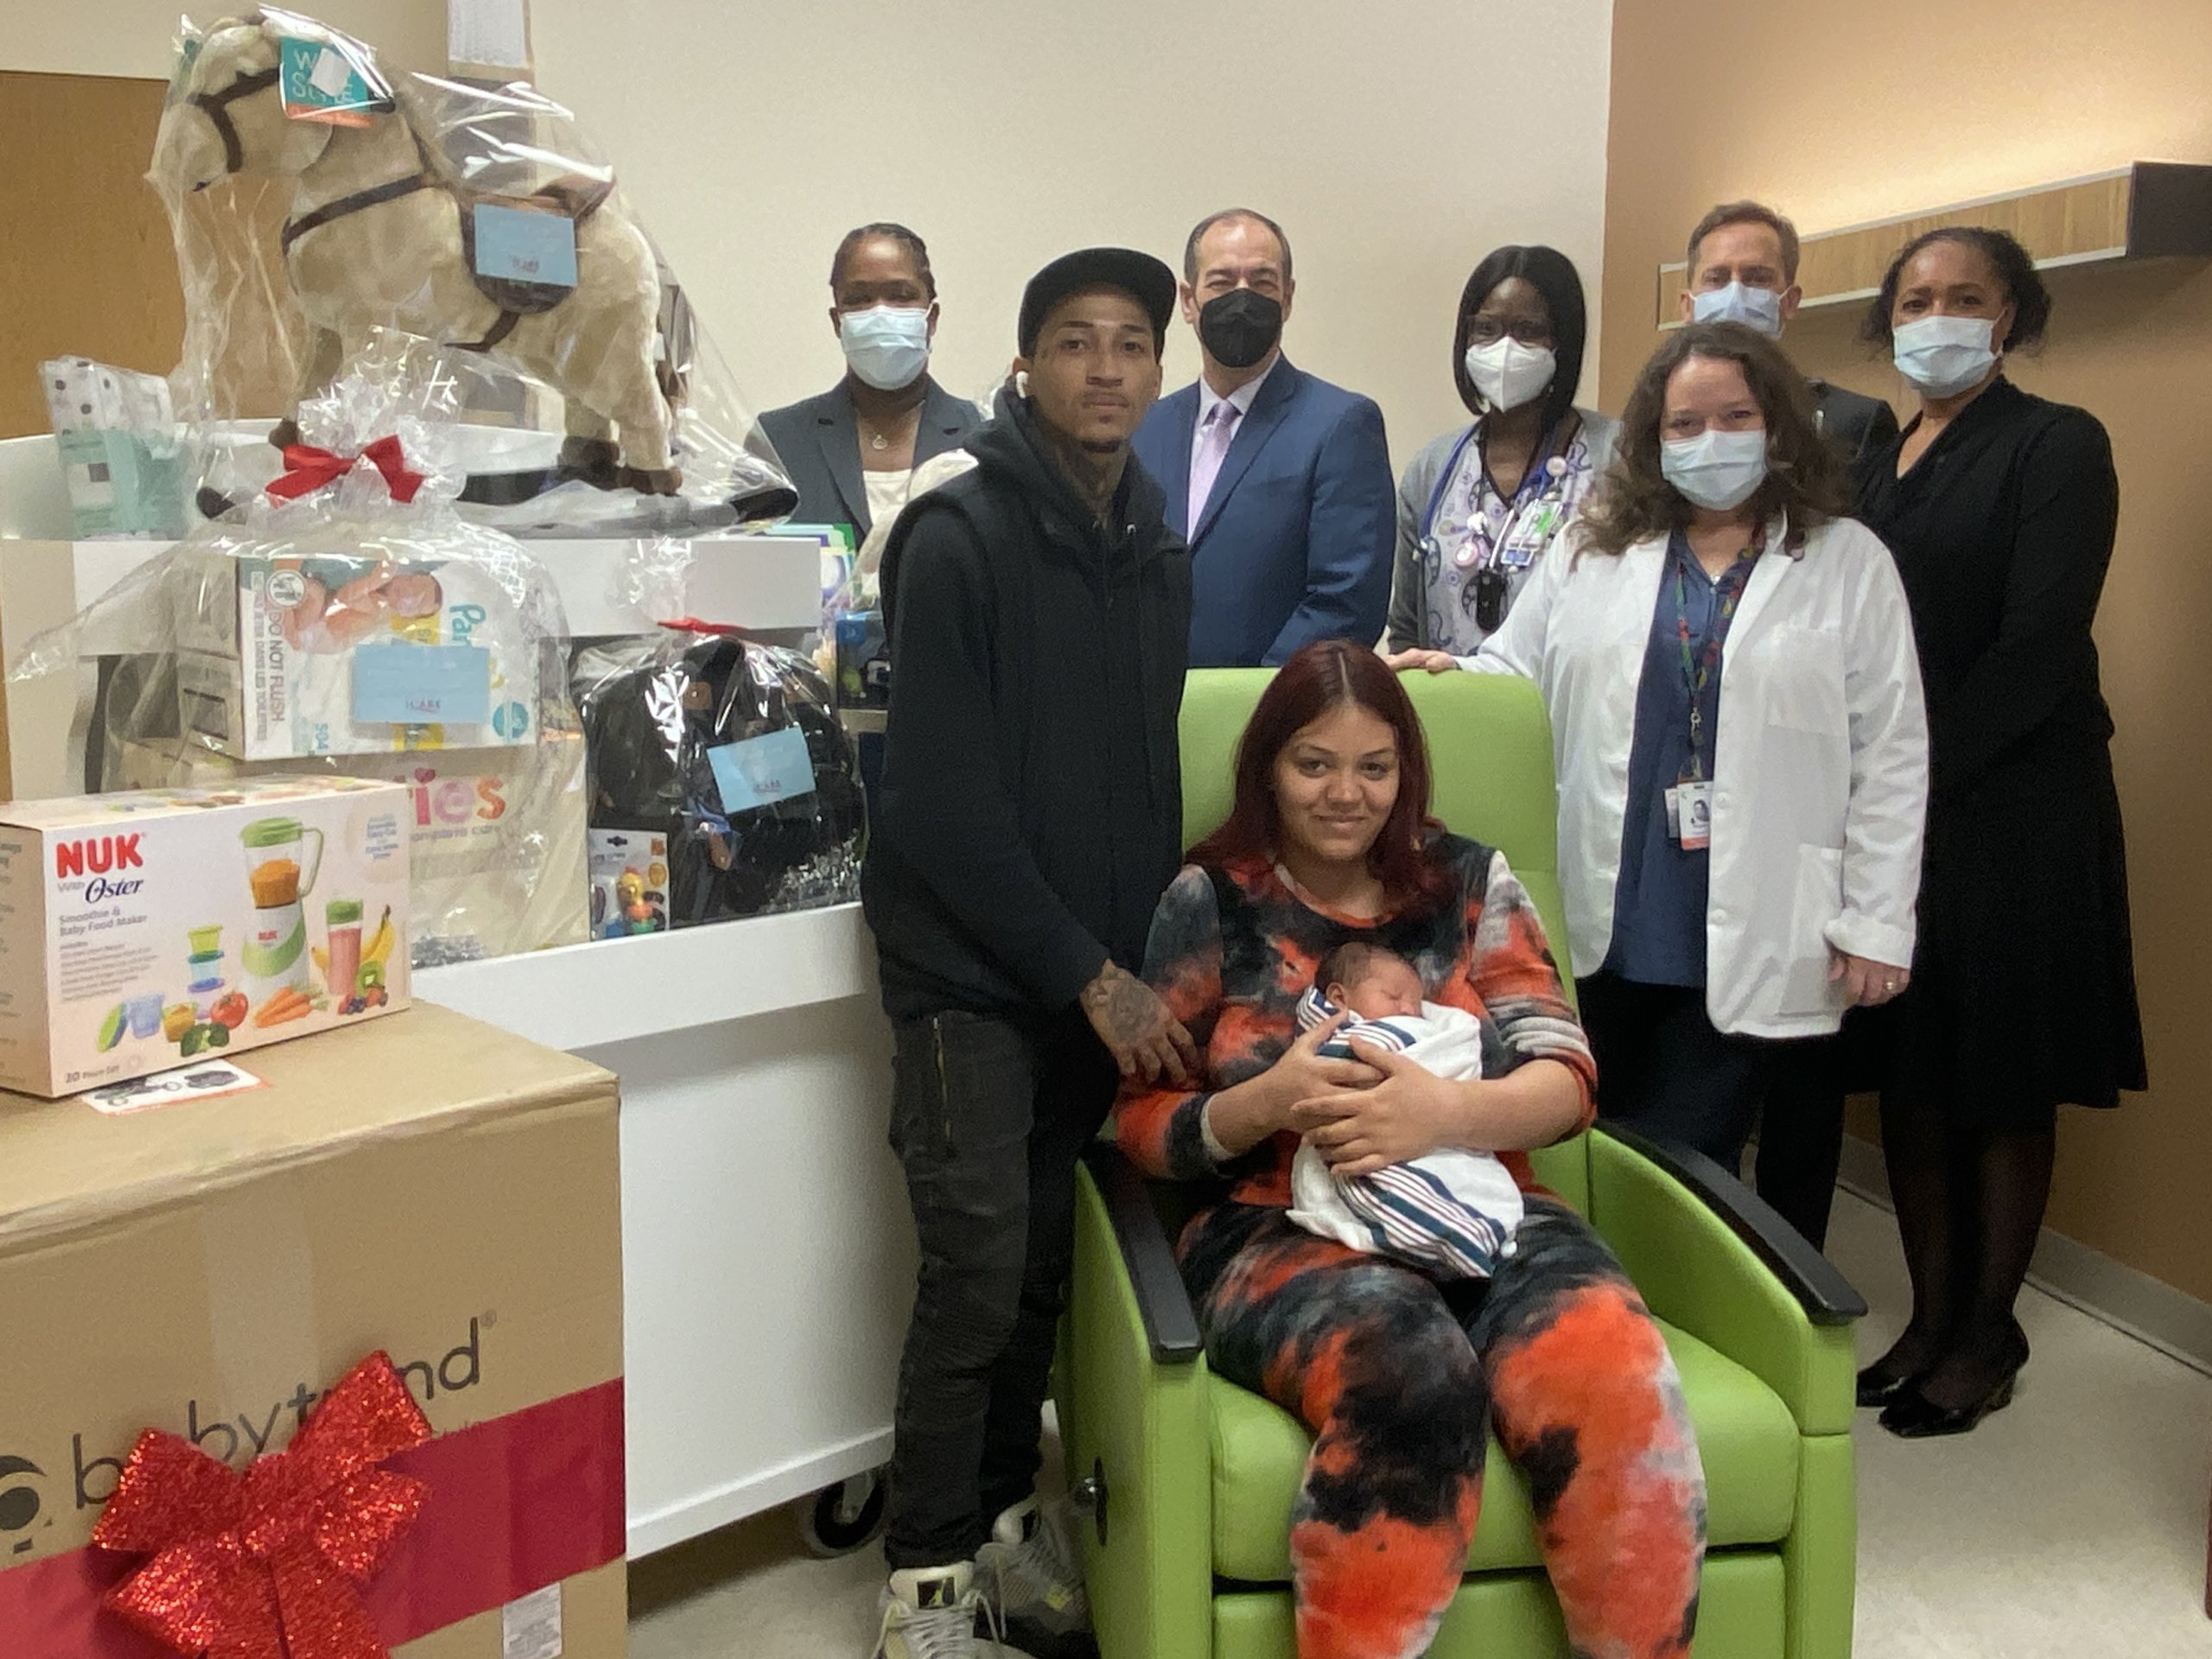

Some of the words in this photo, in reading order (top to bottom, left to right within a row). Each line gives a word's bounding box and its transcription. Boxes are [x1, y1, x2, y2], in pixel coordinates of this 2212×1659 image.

[269, 612, 283, 636] DO
[269, 640, 283, 671] NOT
[270, 676, 285, 721] FLUSH
[409, 767, 506, 826] ies
[56, 832, 143, 879] NUK
[85, 877, 145, 904] Oster
[59, 908, 110, 925] Smoothie
[60, 923, 85, 937] Baby
[88, 918, 113, 931] Food
[117, 914, 148, 927] Maker
[73, 1316, 480, 1509] bbytnd
